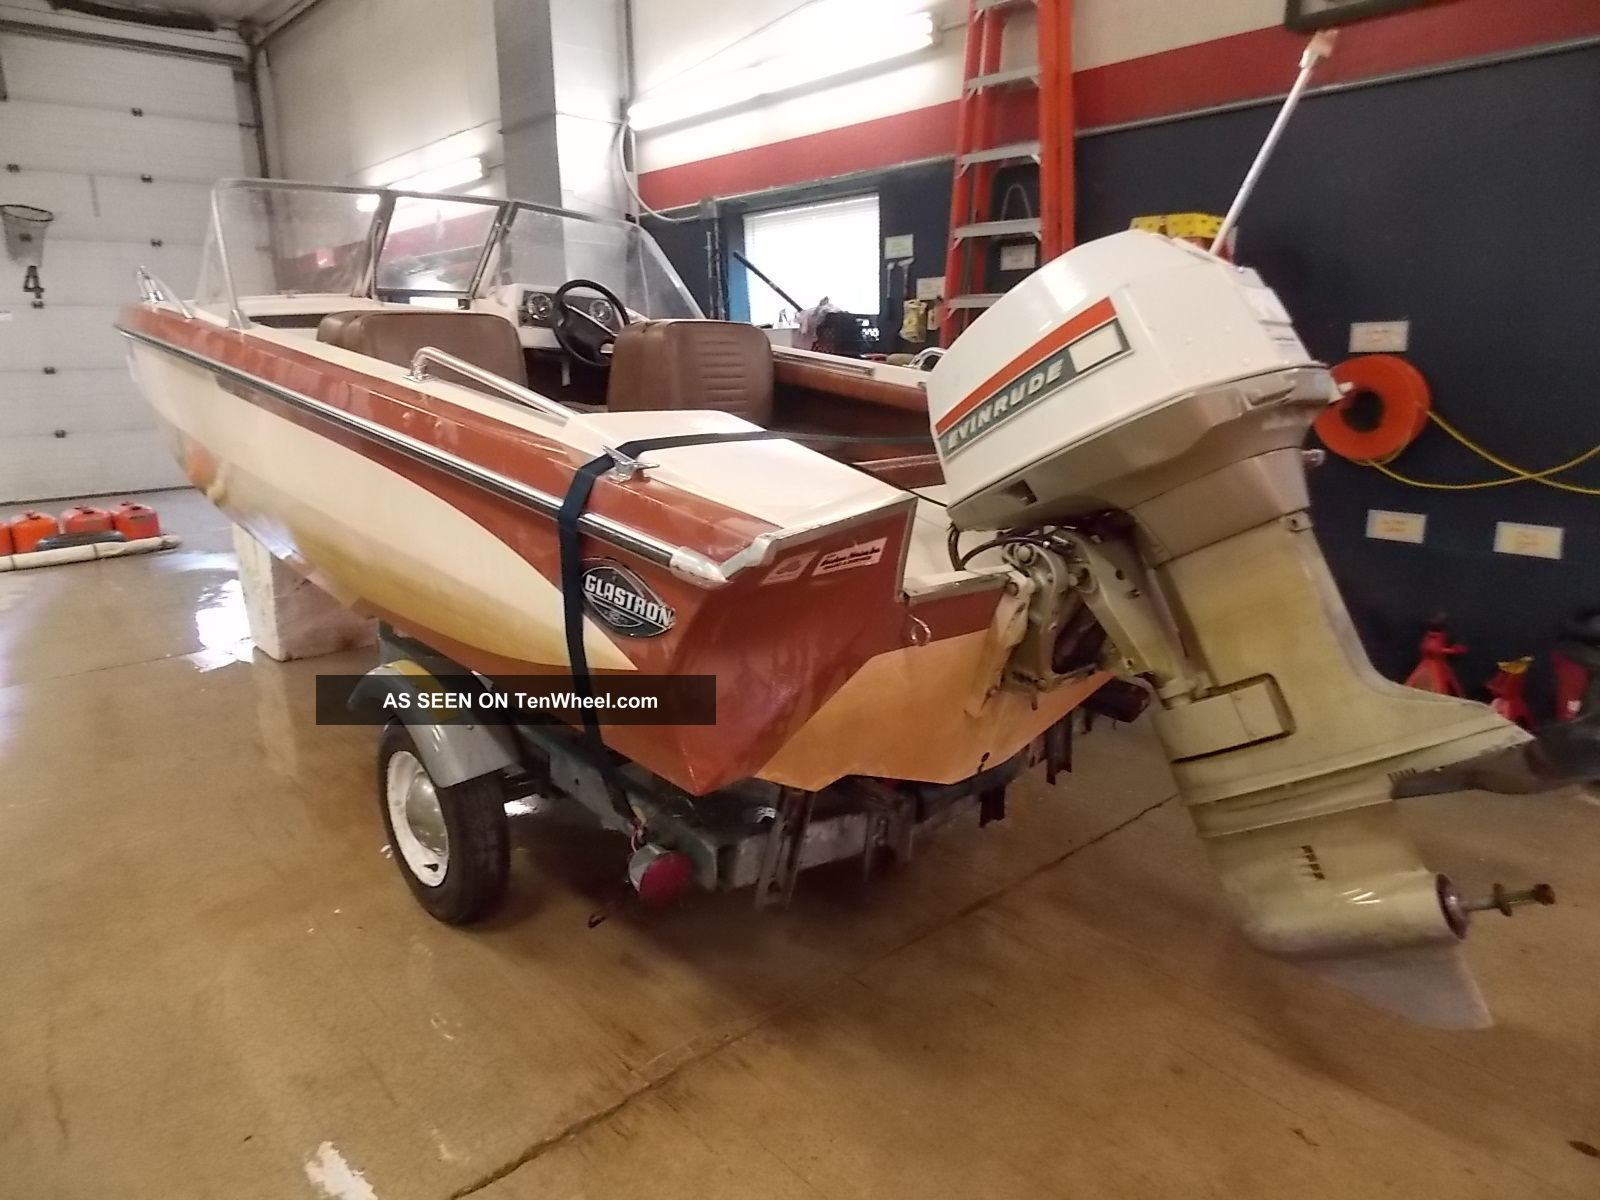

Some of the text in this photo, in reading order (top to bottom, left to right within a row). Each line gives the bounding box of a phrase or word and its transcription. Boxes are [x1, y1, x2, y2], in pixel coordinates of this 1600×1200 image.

[22, 265, 45, 299] 4
[947, 358, 1064, 449] EVINRUDE
[584, 574, 672, 627] GLASTRON
